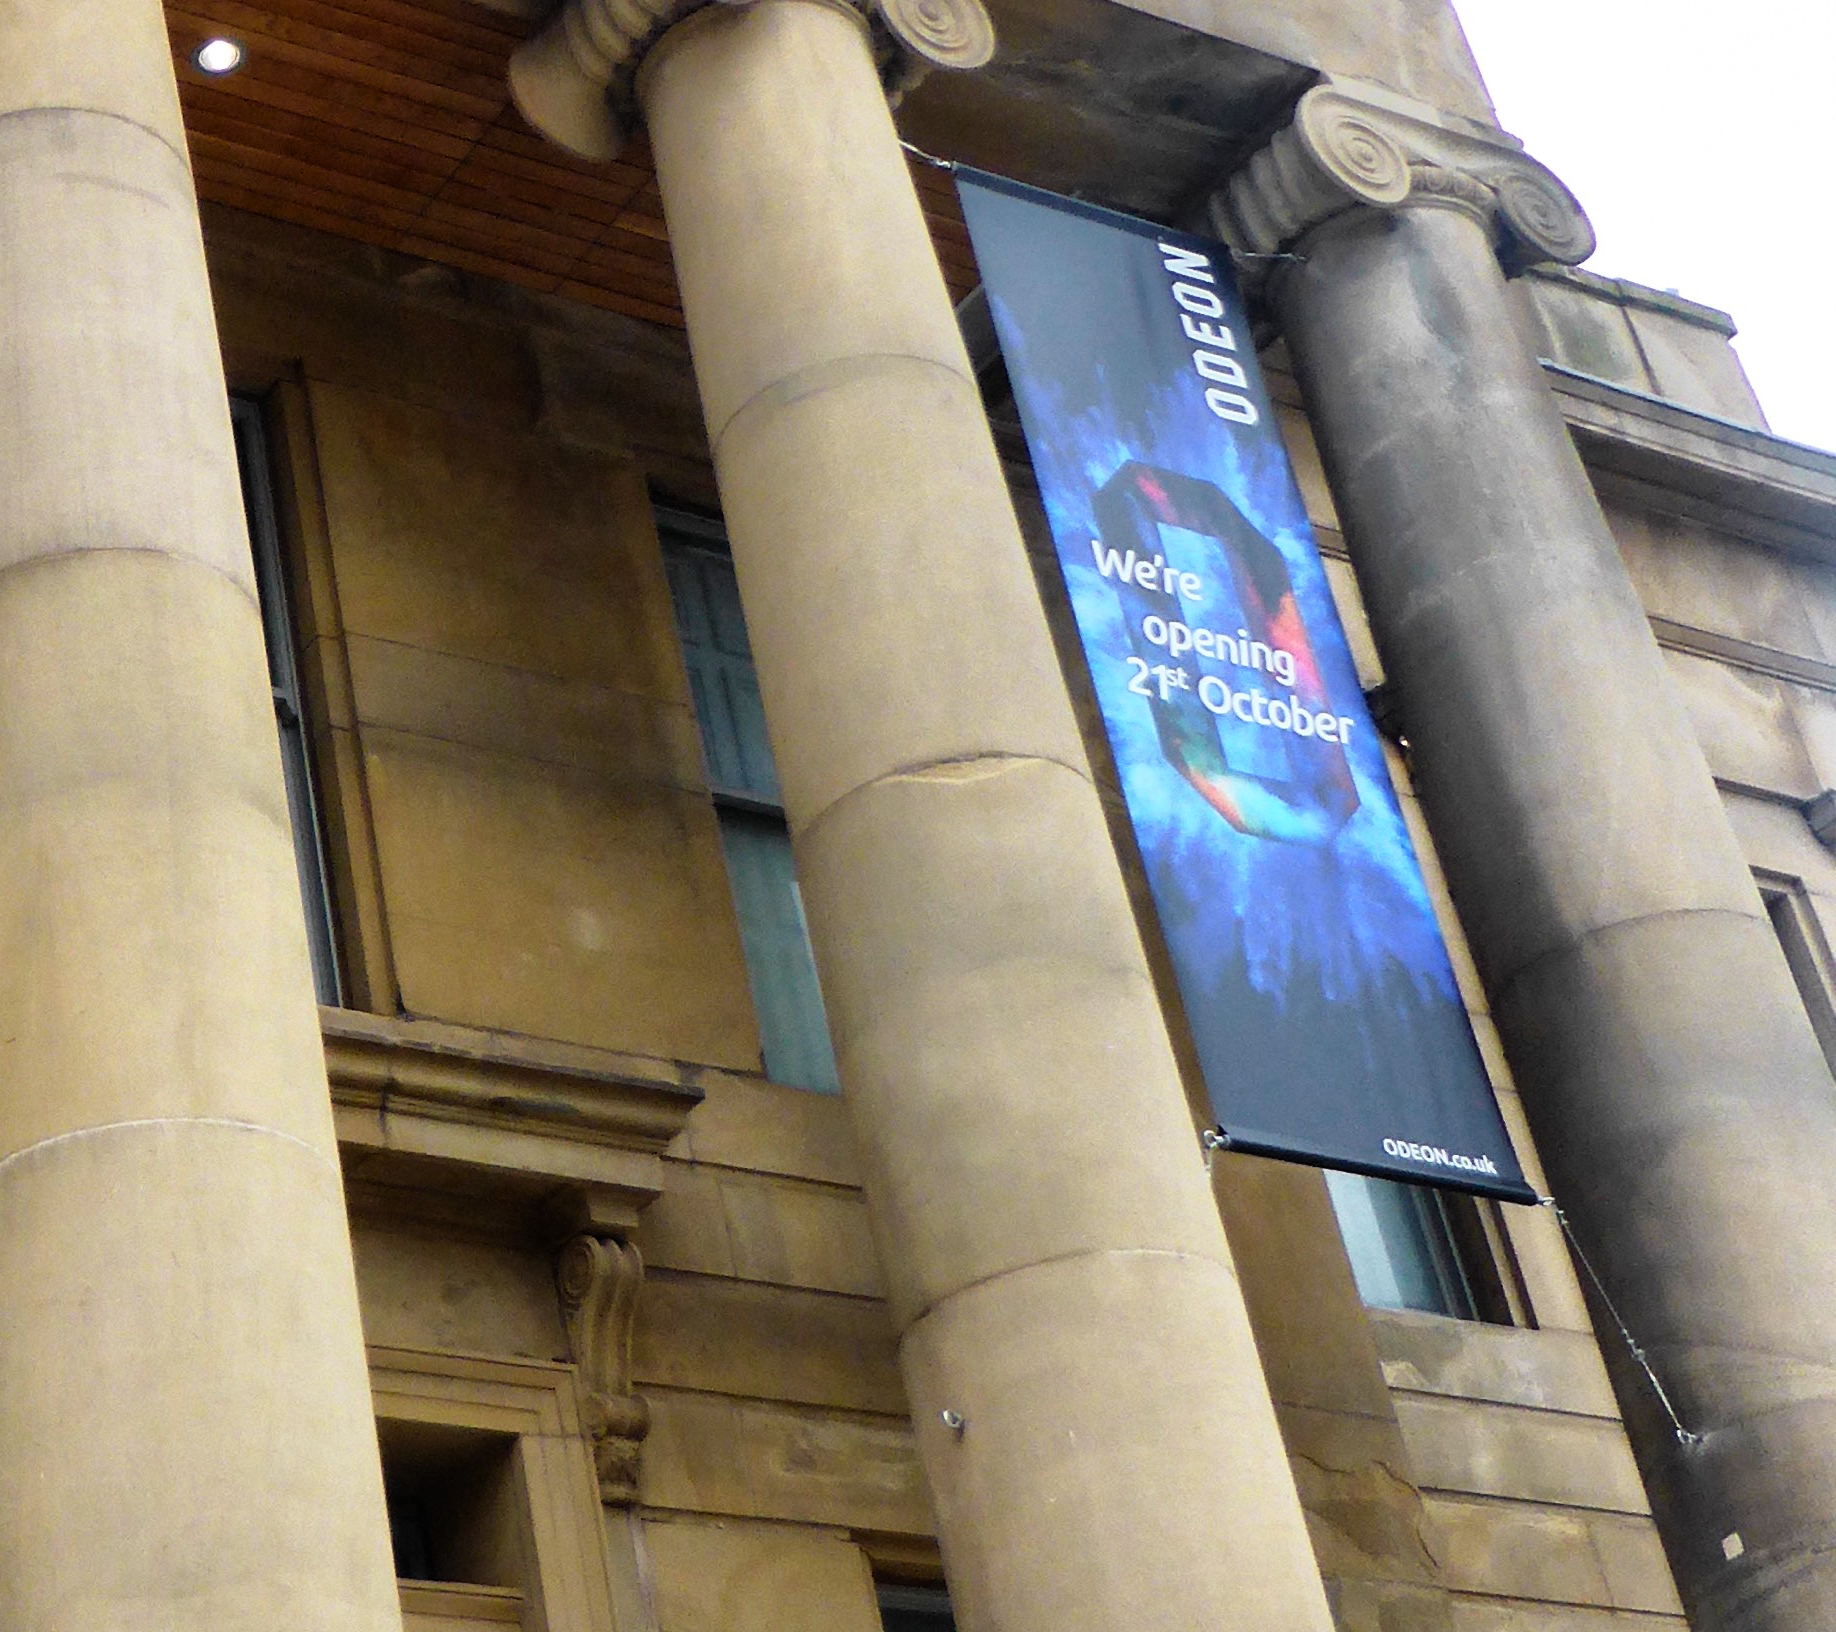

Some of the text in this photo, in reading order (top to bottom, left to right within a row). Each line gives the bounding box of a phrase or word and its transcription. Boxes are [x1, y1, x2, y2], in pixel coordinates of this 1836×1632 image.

[1158, 242, 1260, 427] ODEON
[1091, 540, 1202, 602] We're
[1143, 614, 1296, 687] opening
[1126, 655, 1354, 746] 21st October
[1383, 1138, 1497, 1174] ODEON.co.uk
